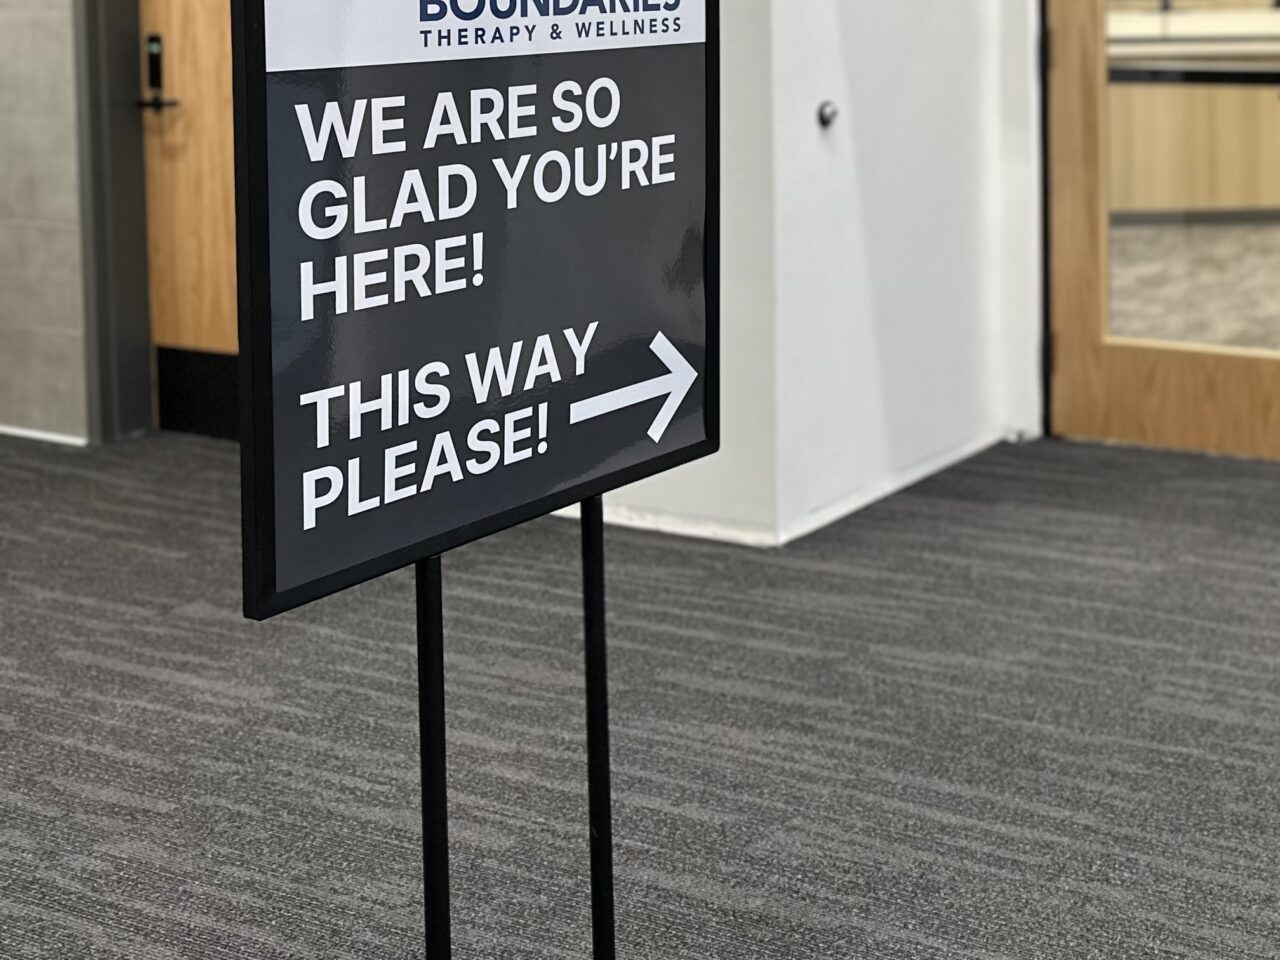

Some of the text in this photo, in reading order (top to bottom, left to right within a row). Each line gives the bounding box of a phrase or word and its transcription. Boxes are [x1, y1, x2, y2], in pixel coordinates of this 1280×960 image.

[420, 17, 682, 47] THERAPY & WELLNESS
[294, 77, 621, 162] WE ARE SO
[298, 134, 676, 240] GLAD YOU'RE
[300, 232, 485, 321] HERE!
[299, 320, 599, 449] THIS WAY
[302, 401, 549, 531] PLEASE!
